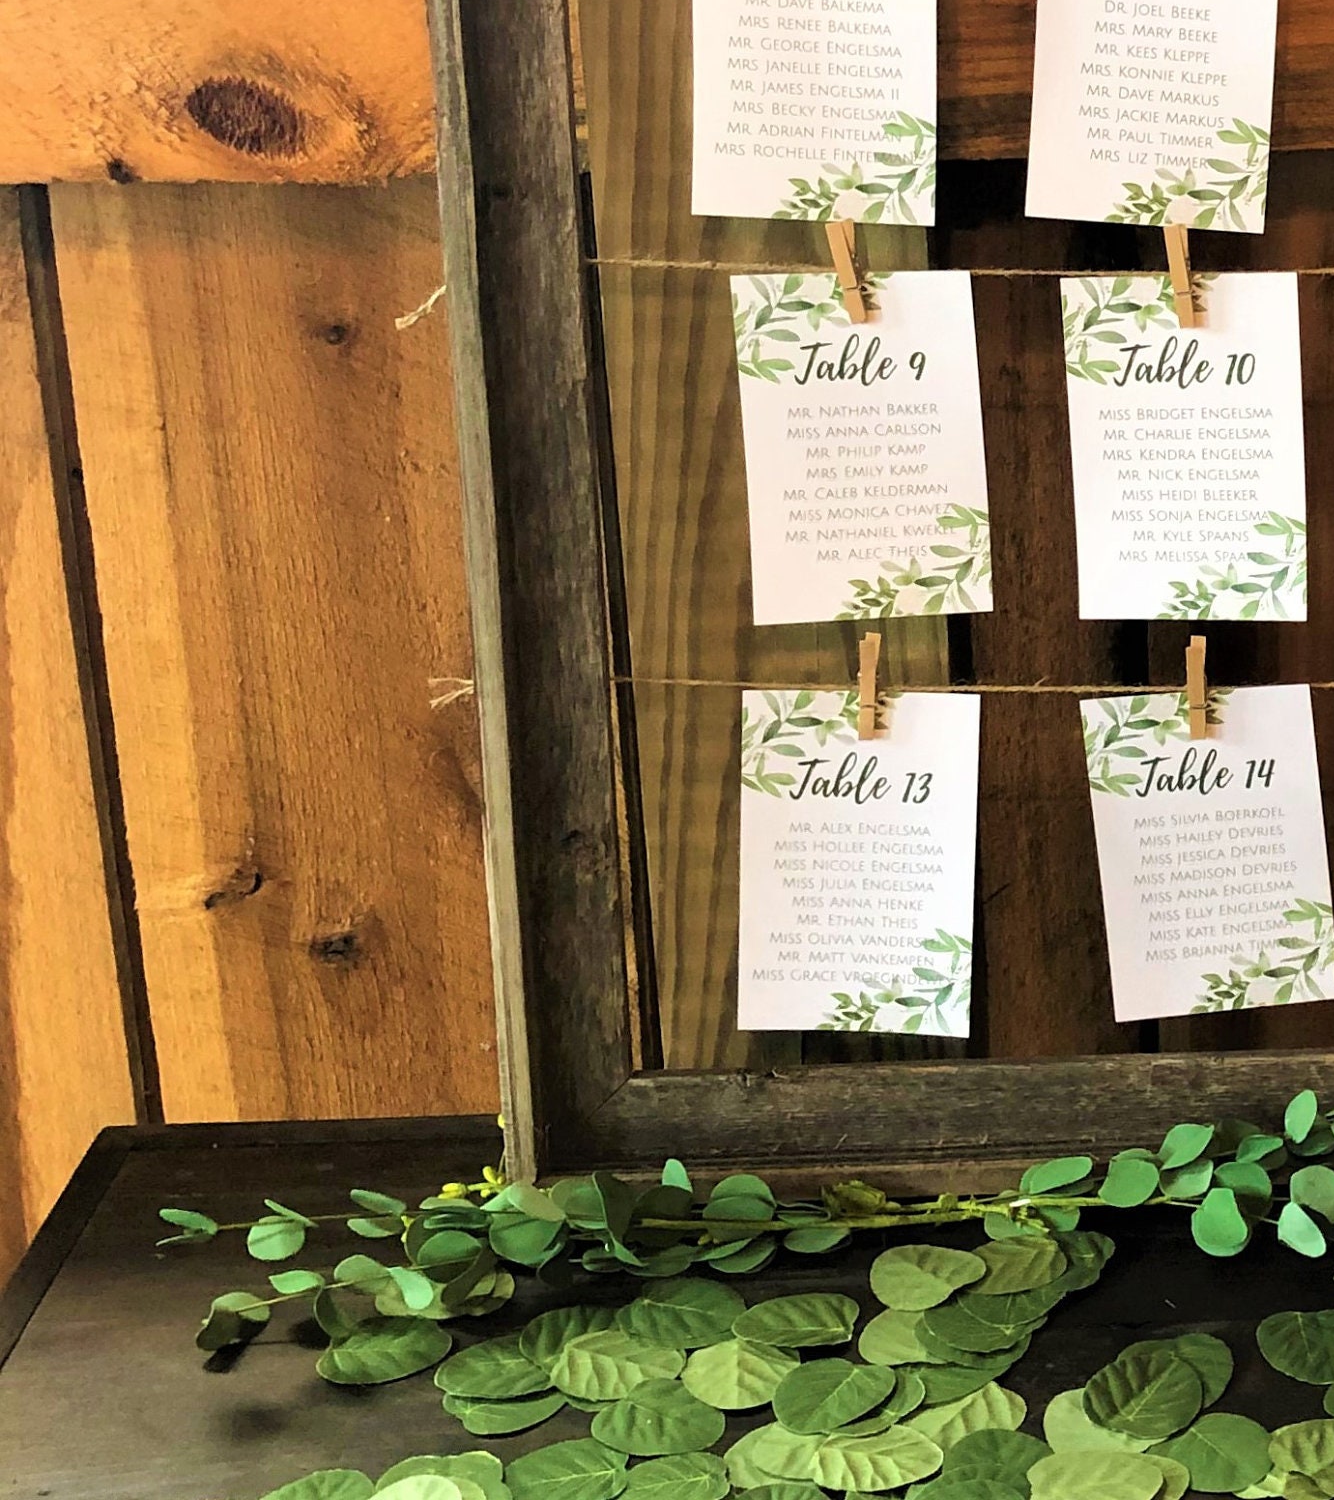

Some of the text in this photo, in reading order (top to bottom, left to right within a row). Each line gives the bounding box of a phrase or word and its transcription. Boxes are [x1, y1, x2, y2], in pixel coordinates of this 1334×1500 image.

[1132, 2, 1211, 22] JOEL BEEKE
[1132, 23, 1218, 44] MARY BEEKE
[760, 37, 903, 59] GEORGE ENGELSMA
[795, 333, 926, 386] Table 9
[1114, 335, 1256, 389] Table 10
[818, 403, 939, 419] NATHAN BAKKER
[1098, 406, 1273, 421] MISS BRIDGET ENGELSMA
[786, 422, 942, 440] MISS ANNA CARLSON
[1134, 427, 1271, 441] CHARLIE ENGELSMA
[1139, 447, 1274, 461] KENDRA ENGELSMA
[790, 751, 932, 804] Table 13
[1135, 747, 1274, 797] Table 14
[1133, 872, 1166, 886] MISS
[1169, 865, 1237, 881] MADISON
[1140, 879, 1295, 905] MISS ANNA ENGELSMA
[791, 895, 923, 912] MISS ANNA HENKE
[827, 913, 919, 930] ETHAN THEIS
